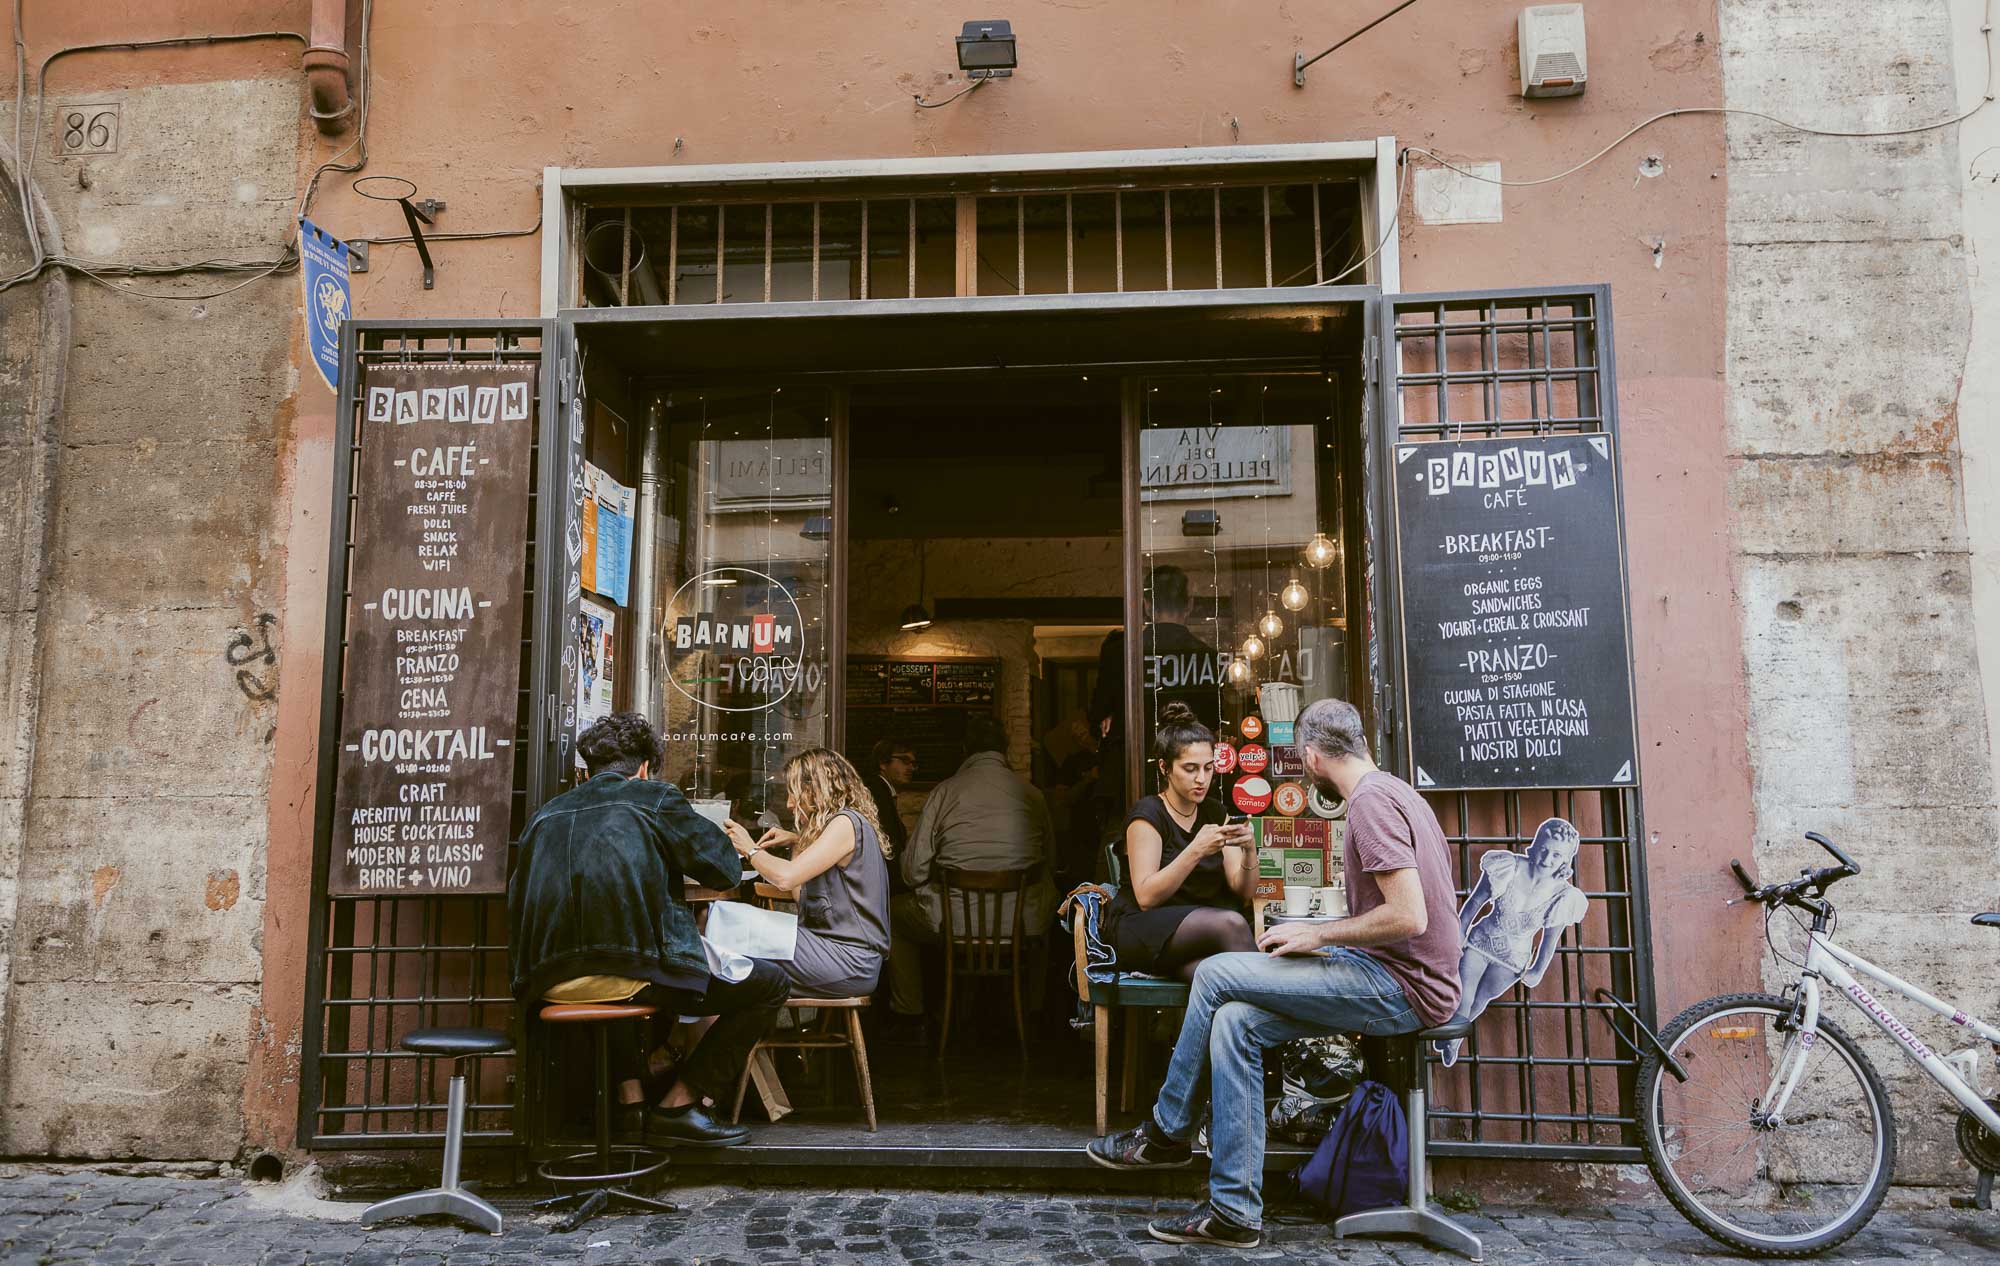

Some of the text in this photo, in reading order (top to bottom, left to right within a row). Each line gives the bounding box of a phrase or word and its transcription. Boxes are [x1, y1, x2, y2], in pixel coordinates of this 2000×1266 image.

[63, 111, 118, 149] 86
[371, 385, 525, 421] BARNUM
[1430, 449, 1574, 493] BARNUM
[1484, 484, 1528, 509] CAFÉ
[407, 504, 467, 515] FRESH JUICE
[423, 519, 451, 530] DOLCI
[423, 532, 457, 543] SNACK
[418, 545, 458, 557] RELAX
[423, 560, 450, 572] WIFI
[1464, 577, 1543, 596] ORGANIC EGGS
[1472, 593, 1542, 615] SANDWICHES
[1438, 619, 1477, 639] YOGURT
[1483, 616, 1519, 634] CEREAL
[1521, 613, 1530, 629] &
[1533, 608, 1590, 629] CROISSANT
[397, 629, 467, 643] BREAKFAST
[676, 620, 792, 649] BARNUM
[396, 654, 459, 674] PRANZO
[400, 687, 448, 710] CENA
[1444, 681, 1556, 705] CUCINA DI STAGIONE
[1457, 699, 1587, 721] PASTA FATTA IN CASA
[662, 732, 793, 742] barnumcafe.com
[1464, 718, 1589, 741] PIATTI VEGETARIANI
[1240, 752, 1257, 762] yelp
[1460, 738, 1561, 762] I NOSTRI DOLCI
[1284, 762, 1302, 770] Roma
[400, 783, 446, 803] CRAFT
[351, 805, 480, 825] APERITIVI ITALIANI
[355, 824, 474, 844] HOUSE COCKTAILS
[1273, 822, 1292, 832] 2015
[1304, 822, 1323, 832] 2014
[1273, 835, 1292, 843] Roma
[1304, 835, 1323, 843] Roma
[346, 843, 484, 866] MODERN & CLASSIC
[359, 867, 406, 889] BIRRE
[428, 866, 471, 888] VINO
[1288, 874, 1319, 882] tripadvisor
